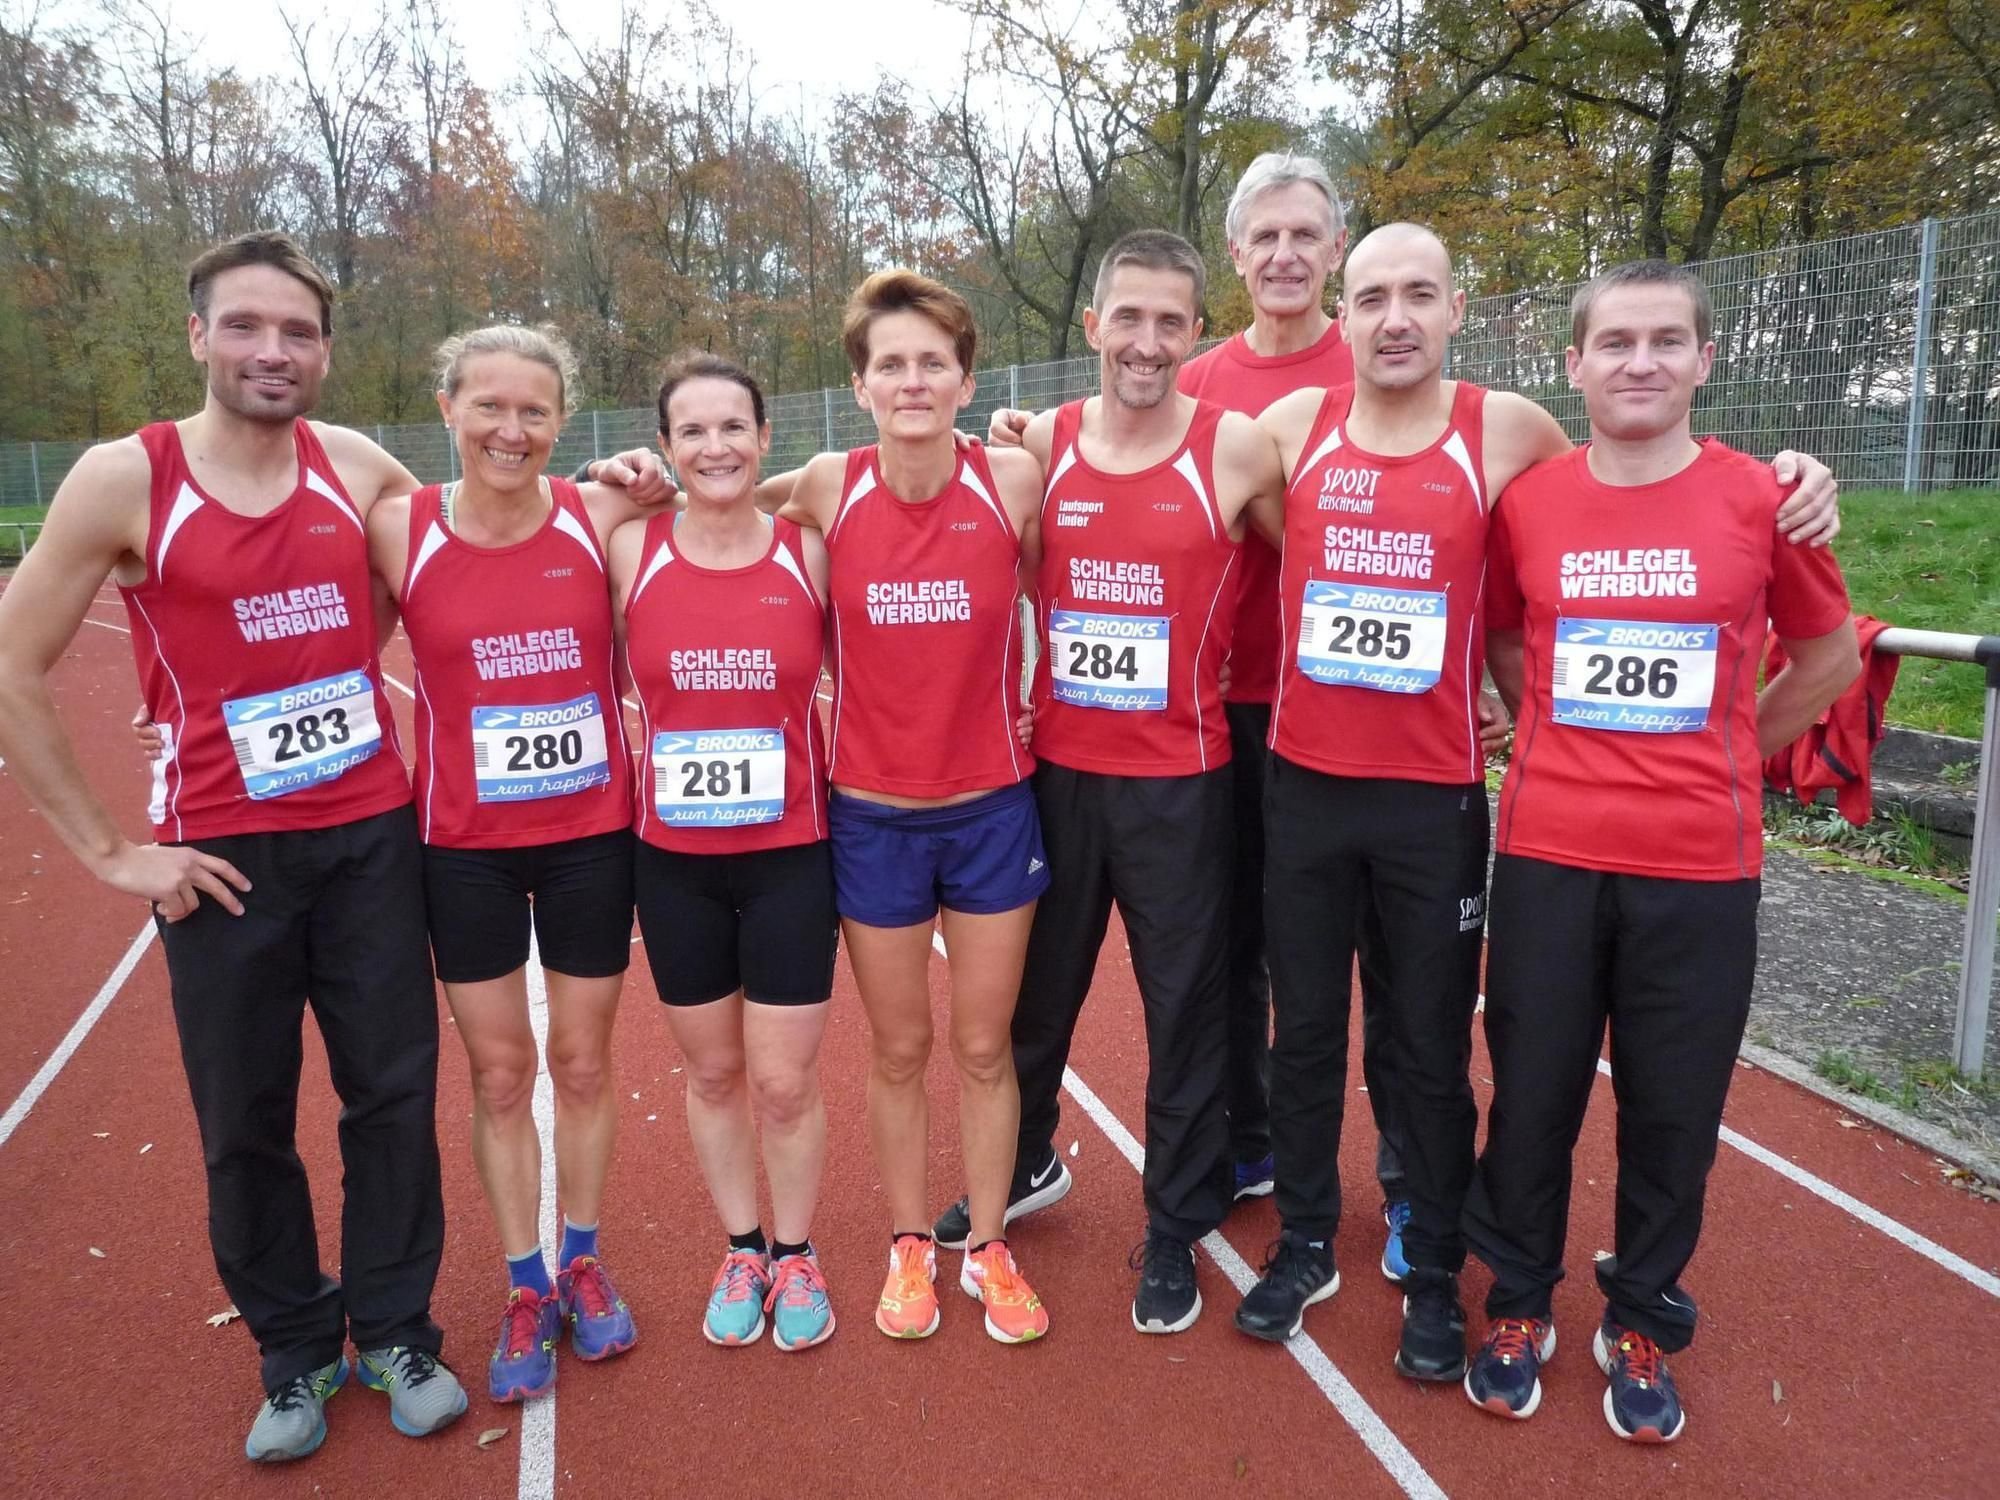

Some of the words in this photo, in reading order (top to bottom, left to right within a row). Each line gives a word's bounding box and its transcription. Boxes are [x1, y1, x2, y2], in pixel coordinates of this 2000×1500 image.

[1321, 468, 1382, 496] SPORT
[1059, 499, 1104, 513] Laufsport
[1057, 513, 1089, 527] Linder
[1325, 525, 1435, 556] SCHLEGEL
[1070, 558, 1165, 585] SCHLEGEL
[1324, 548, 1432, 580] WERBUNG
[1561, 549, 1697, 575] SCHLEGEL
[867, 580, 970, 604] SCHLEGEL
[1071, 579, 1164, 605] WERBUNG
[1560, 573, 1697, 599] WERBUNG
[233, 583, 345, 621] SCHLEGEL
[867, 601, 971, 625] WERBUNG
[1350, 592, 1438, 614] BROOKS
[238, 605, 350, 643] WERBUNG
[1082, 619, 1160, 637] BROOKS
[1328, 615, 1411, 660] 285
[1606, 627, 1707, 648] BROOKS
[472, 627, 580, 659] SCHLEGEL
[475, 648, 581, 681] WERBUNG
[670, 649, 776, 671] SCHLEGEL
[1069, 641, 1138, 681] 284
[671, 670, 776, 690] WERBUNG
[1314, 664, 1350, 679] run
[1353, 669, 1422, 691] happy
[1584, 654, 1678, 699] 286
[280, 677, 361, 713] BROOKS
[1059, 687, 1088, 700] run
[1091, 688, 1150, 709] happy
[519, 700, 593, 727] BROOKS
[1570, 708, 1610, 722] run
[1614, 708, 1692, 731] happy
[268, 707, 351, 763] 283
[695, 734, 774, 751] BROOKS
[505, 730, 582, 772] 280
[266, 772, 309, 791] run
[314, 749, 373, 784] happy
[681, 759, 751, 797] 281
[495, 781, 535, 796] run
[538, 772, 596, 796] happy
[673, 807, 708, 821] run
[711, 806, 769, 822] happy
